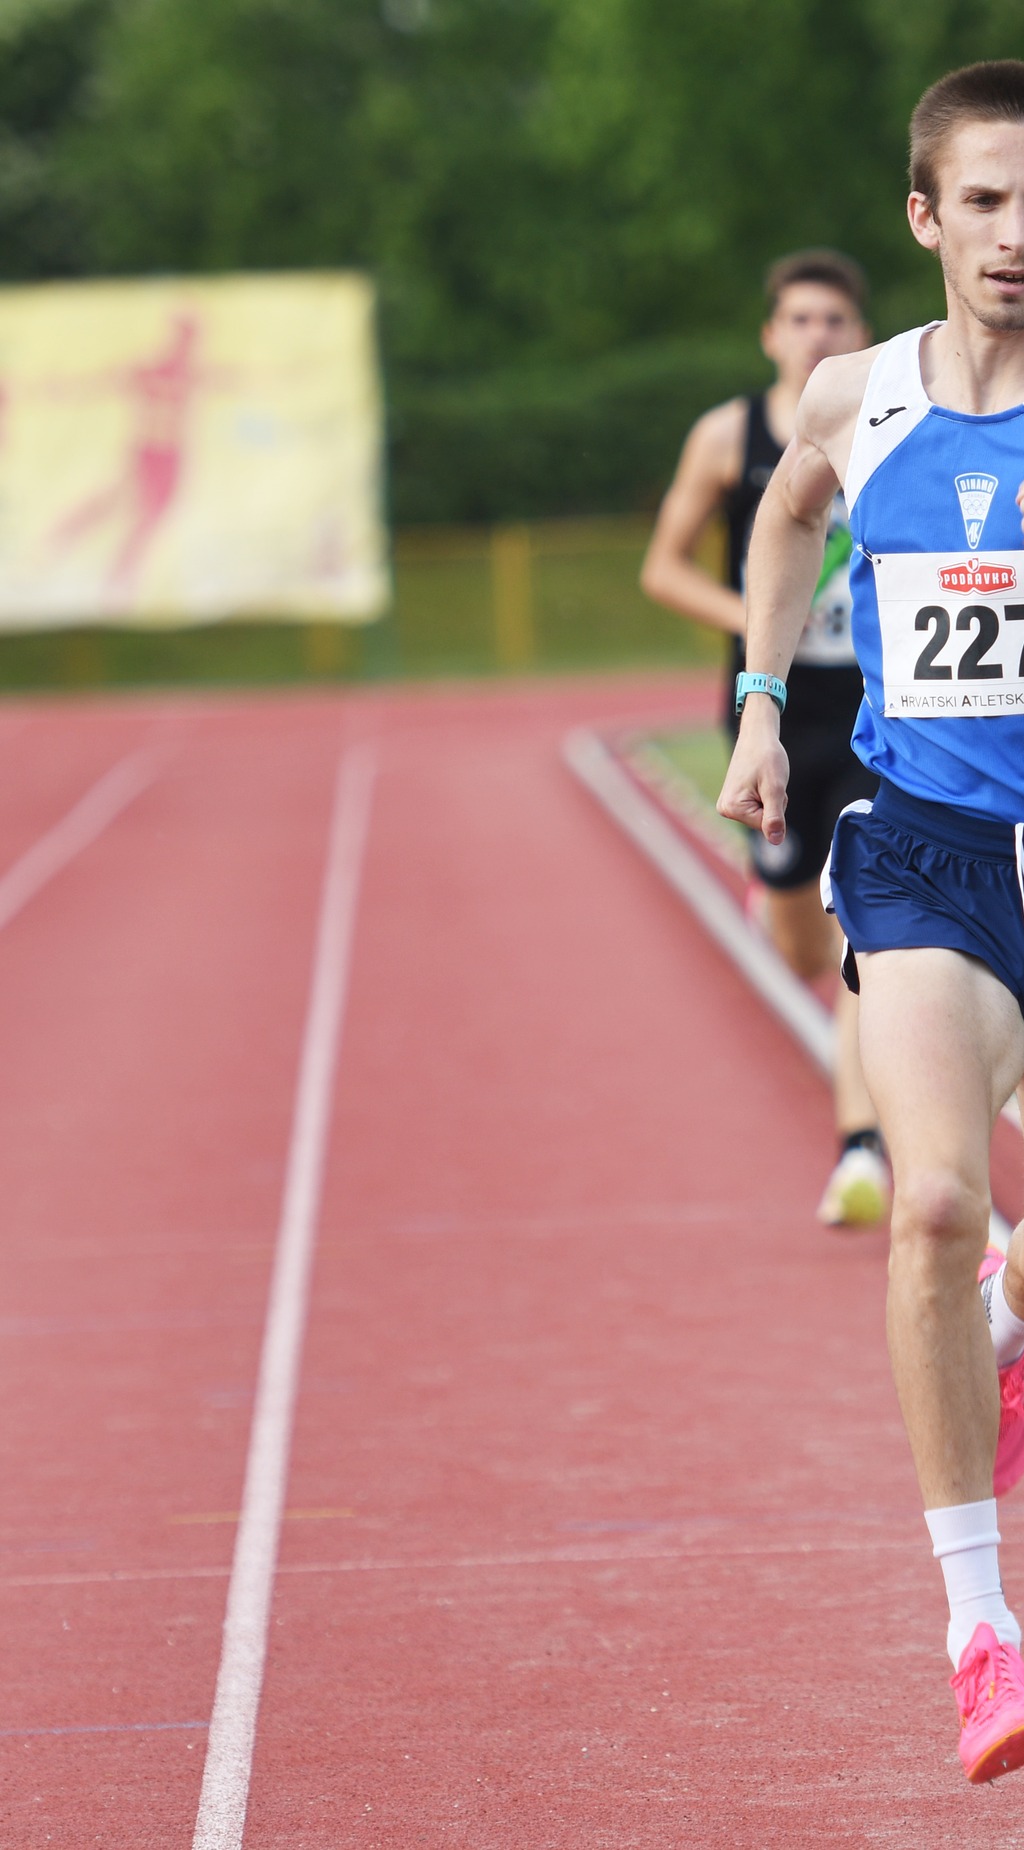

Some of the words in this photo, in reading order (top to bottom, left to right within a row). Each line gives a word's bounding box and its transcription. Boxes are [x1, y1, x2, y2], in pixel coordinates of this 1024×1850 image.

[960, 478, 994, 493] DINAMO
[943, 571, 1010, 586] PODRAVKA
[901, 695, 957, 708] HRVATSKI
